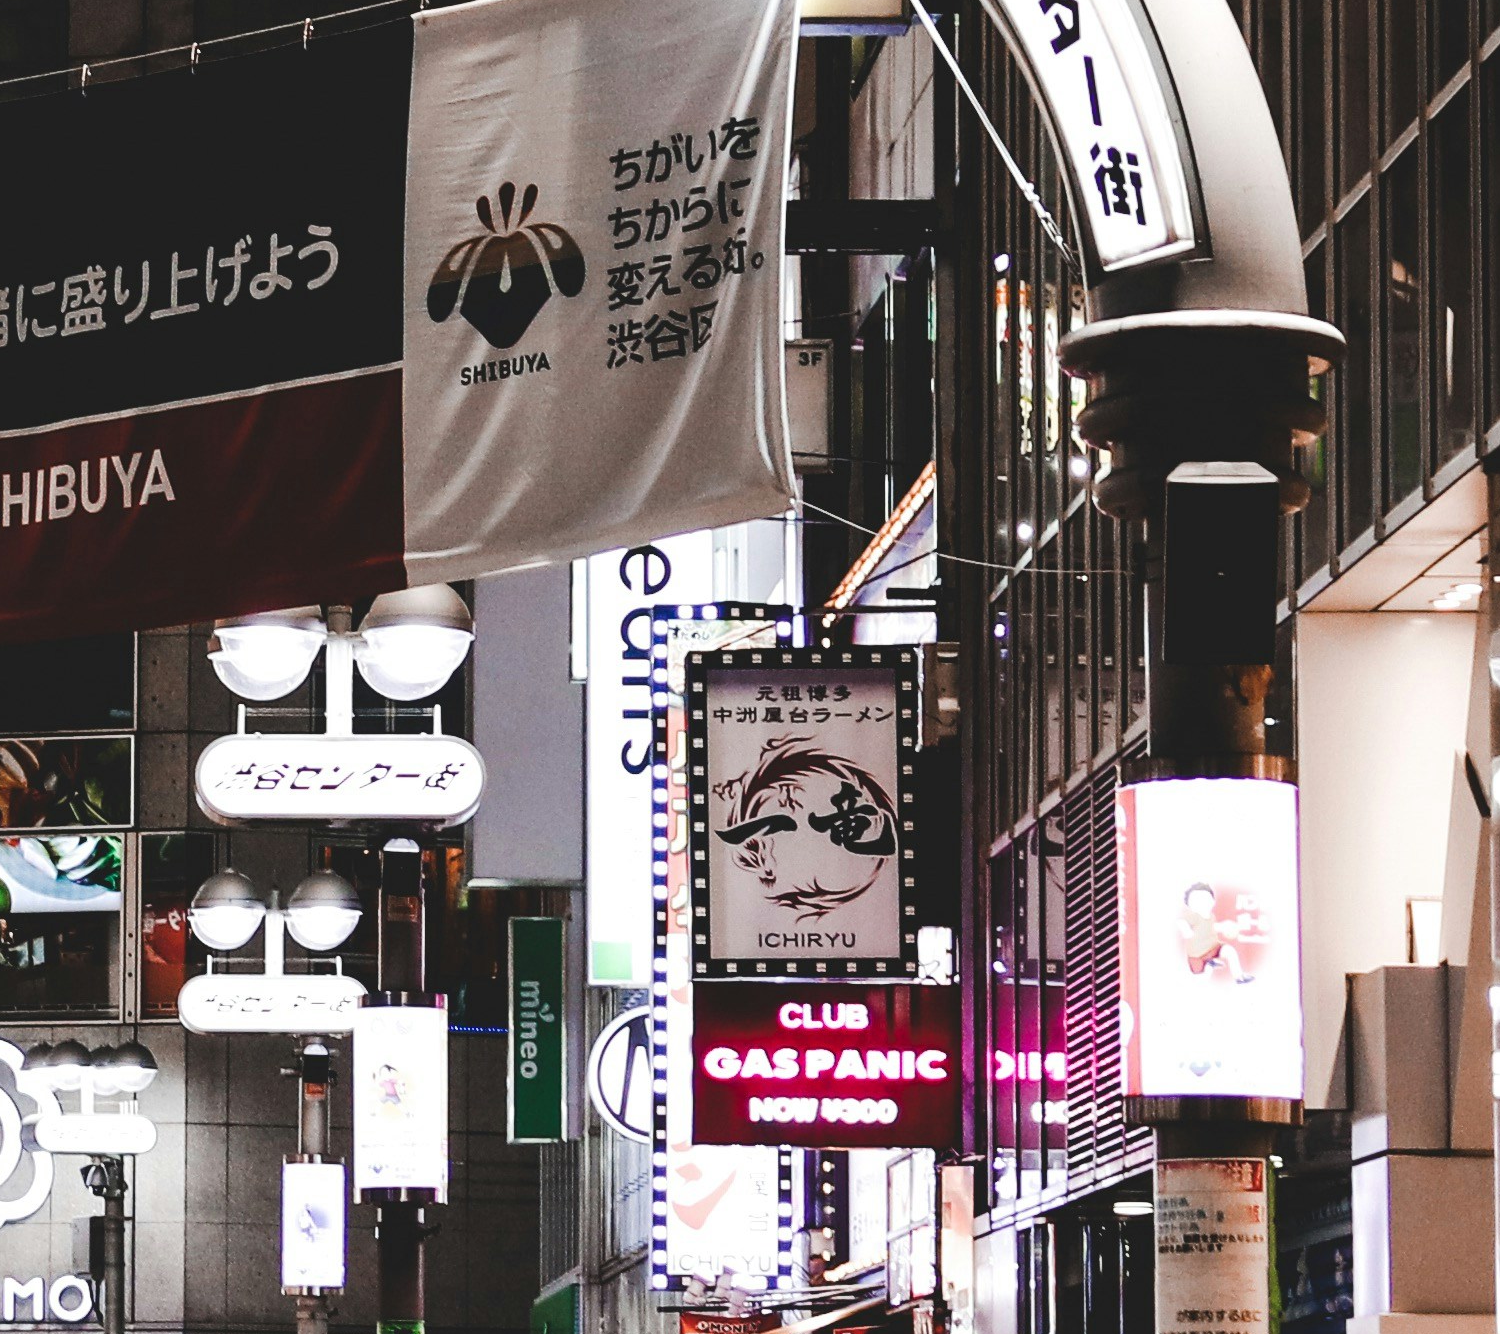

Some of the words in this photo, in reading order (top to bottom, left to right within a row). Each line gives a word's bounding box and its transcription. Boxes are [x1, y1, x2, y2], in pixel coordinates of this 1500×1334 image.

[609, 117, 760, 192] ちがいを
[608, 178, 751, 251] ちからに
[460, 351, 552, 386] SHIBUYA
[798, 351, 823, 367] 3F
[755, 685, 852, 702] 元祖博多
[713, 705, 894, 725] 中洲屋台ラーメン
[758, 933, 856, 949] ICHIRYU
[519, 980, 555, 1080] mineo
[779, 1003, 869, 1030] CLUB
[703, 1047, 800, 1081] GAS
[803, 1048, 948, 1081] PANIC
[750, 1098, 817, 1124] NOW
